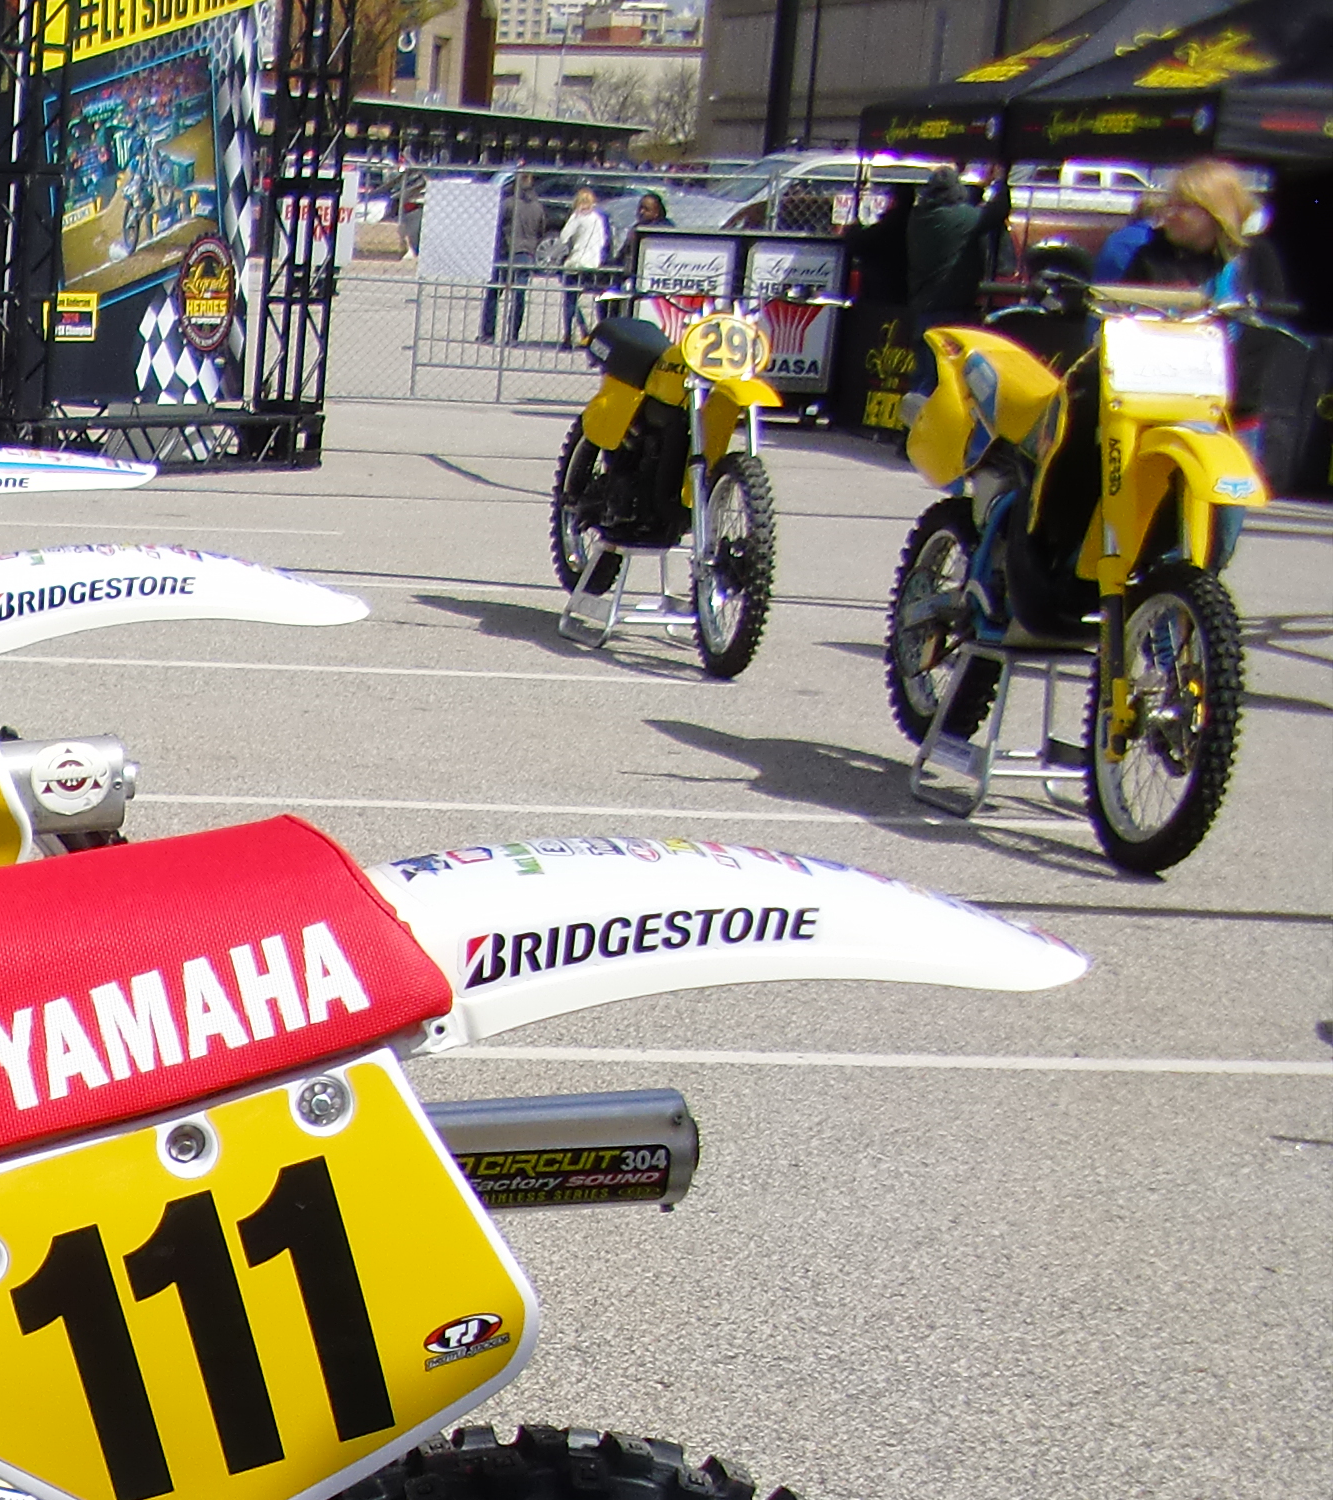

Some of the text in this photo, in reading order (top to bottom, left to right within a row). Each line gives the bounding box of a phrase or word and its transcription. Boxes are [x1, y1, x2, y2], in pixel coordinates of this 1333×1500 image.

[700, 322, 747, 368] 29
[464, 905, 821, 991] BRIDGESTONE
[477, 1149, 668, 1177] CIRCUIT 304
[564, 1171, 661, 1188] SOUND
[554, 1188, 609, 1201] SERIES
